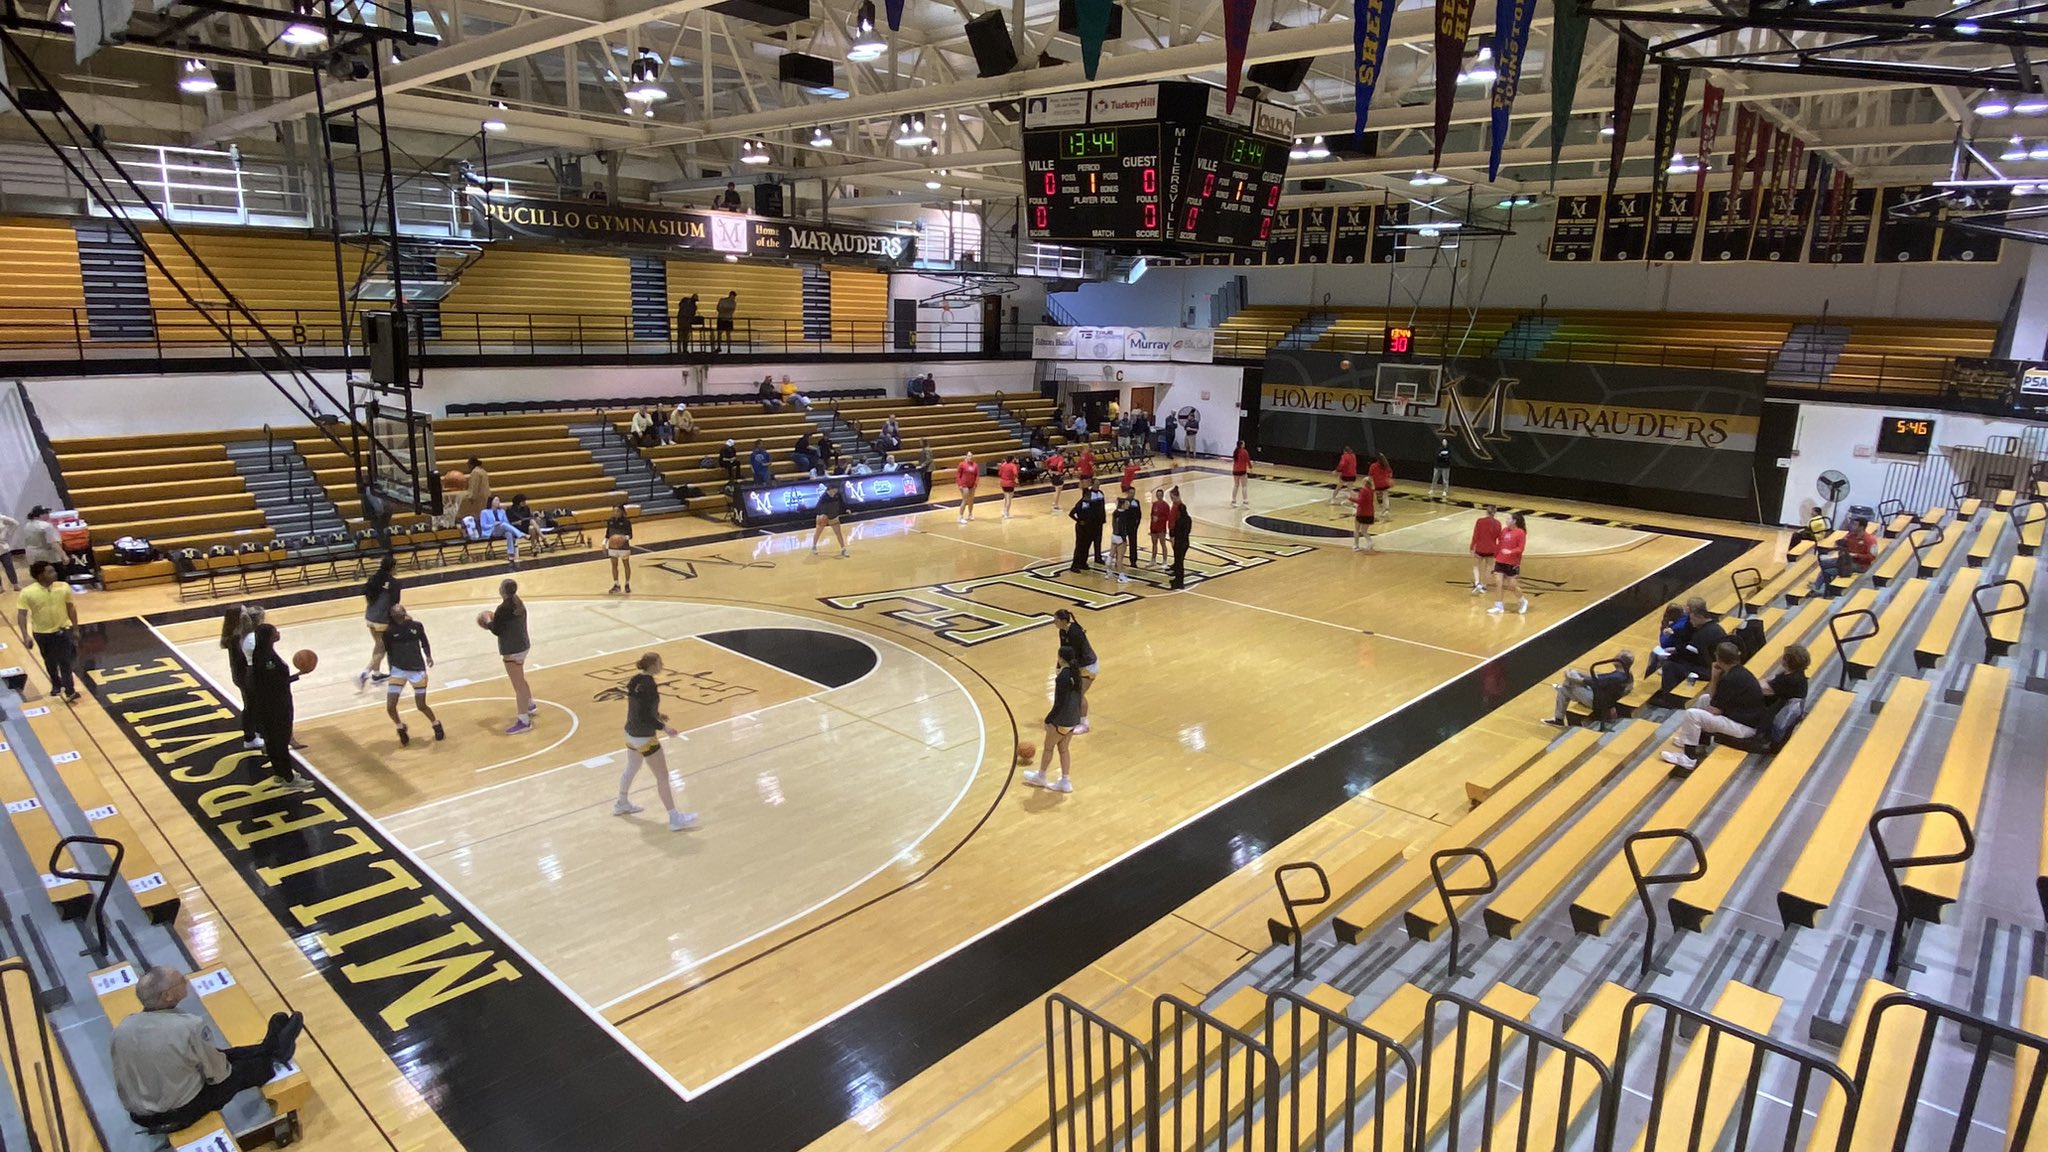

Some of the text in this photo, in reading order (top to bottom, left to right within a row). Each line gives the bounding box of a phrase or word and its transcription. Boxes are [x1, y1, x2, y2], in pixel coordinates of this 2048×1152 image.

[1504, 0, 1525, 109] JOHNSTO
[1029, 160, 1055, 171] VILLE
[1122, 156, 1157, 167] GUEST
[1198, 158, 1218, 172] VILLE
[1044, 172, 1056, 195] 0
[1090, 173, 1096, 194] 1
[1143, 169, 1156, 193] 0
[1166, 128, 1186, 239] MILLERSVILLE
[1100, 196, 1118, 204] FOUL
[1136, 195, 1158, 203] FOULS
[483, 203, 705, 239] PUCILLO GYMNASIUM
[1036, 206, 1047, 228] 0
[1145, 204, 1156, 228] 0
[756, 237, 780, 248] of the
[789, 226, 903, 259] MARAUDERS
[1136, 230, 1159, 238] SCORE
[293, 325, 307, 344] B
[1130, 338, 1170, 350] Murray
[1389, 338, 1408, 352] 30
[1115, 370, 1124, 381] C
[1272, 388, 1337, 411] HOME
[1342, 392, 1372, 413] OF
[1523, 402, 1728, 448] MARAUDERS
[1896, 420, 1928, 435] 5:46
[88, 657, 523, 1032] MILLERSVILLE
